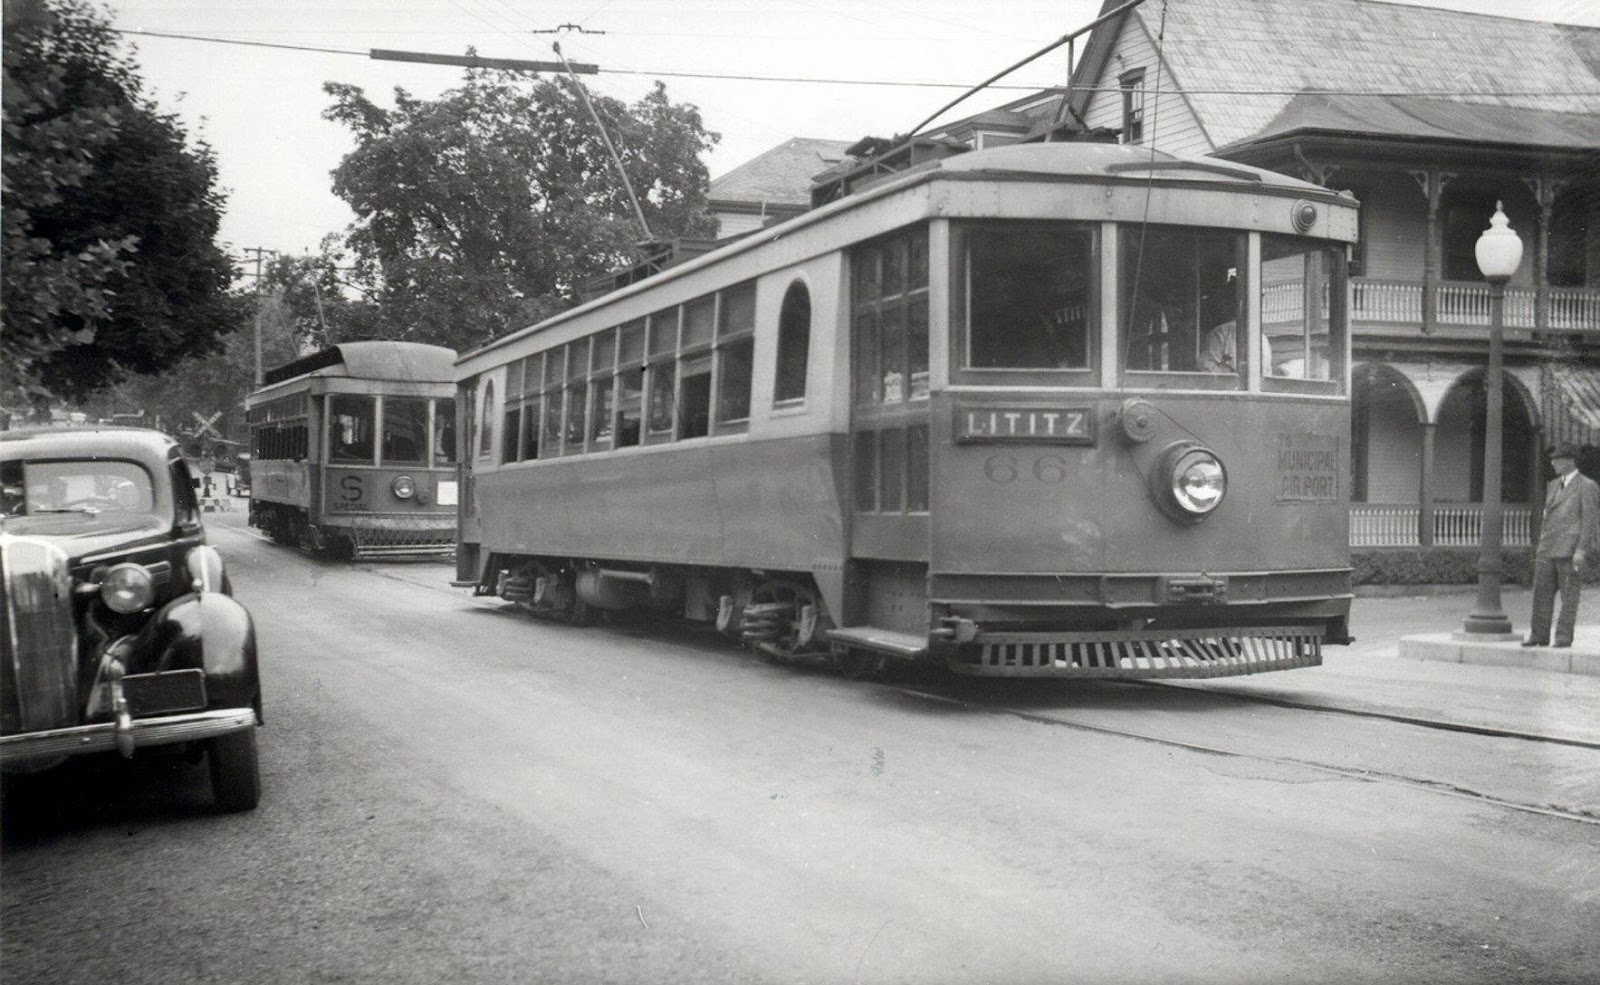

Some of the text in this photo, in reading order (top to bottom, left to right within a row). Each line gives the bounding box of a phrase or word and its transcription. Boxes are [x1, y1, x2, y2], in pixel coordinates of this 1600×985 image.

[967, 412, 1083, 435] LITITZ
[984, 454, 1067, 483] 66
[341, 475, 362, 501] S
